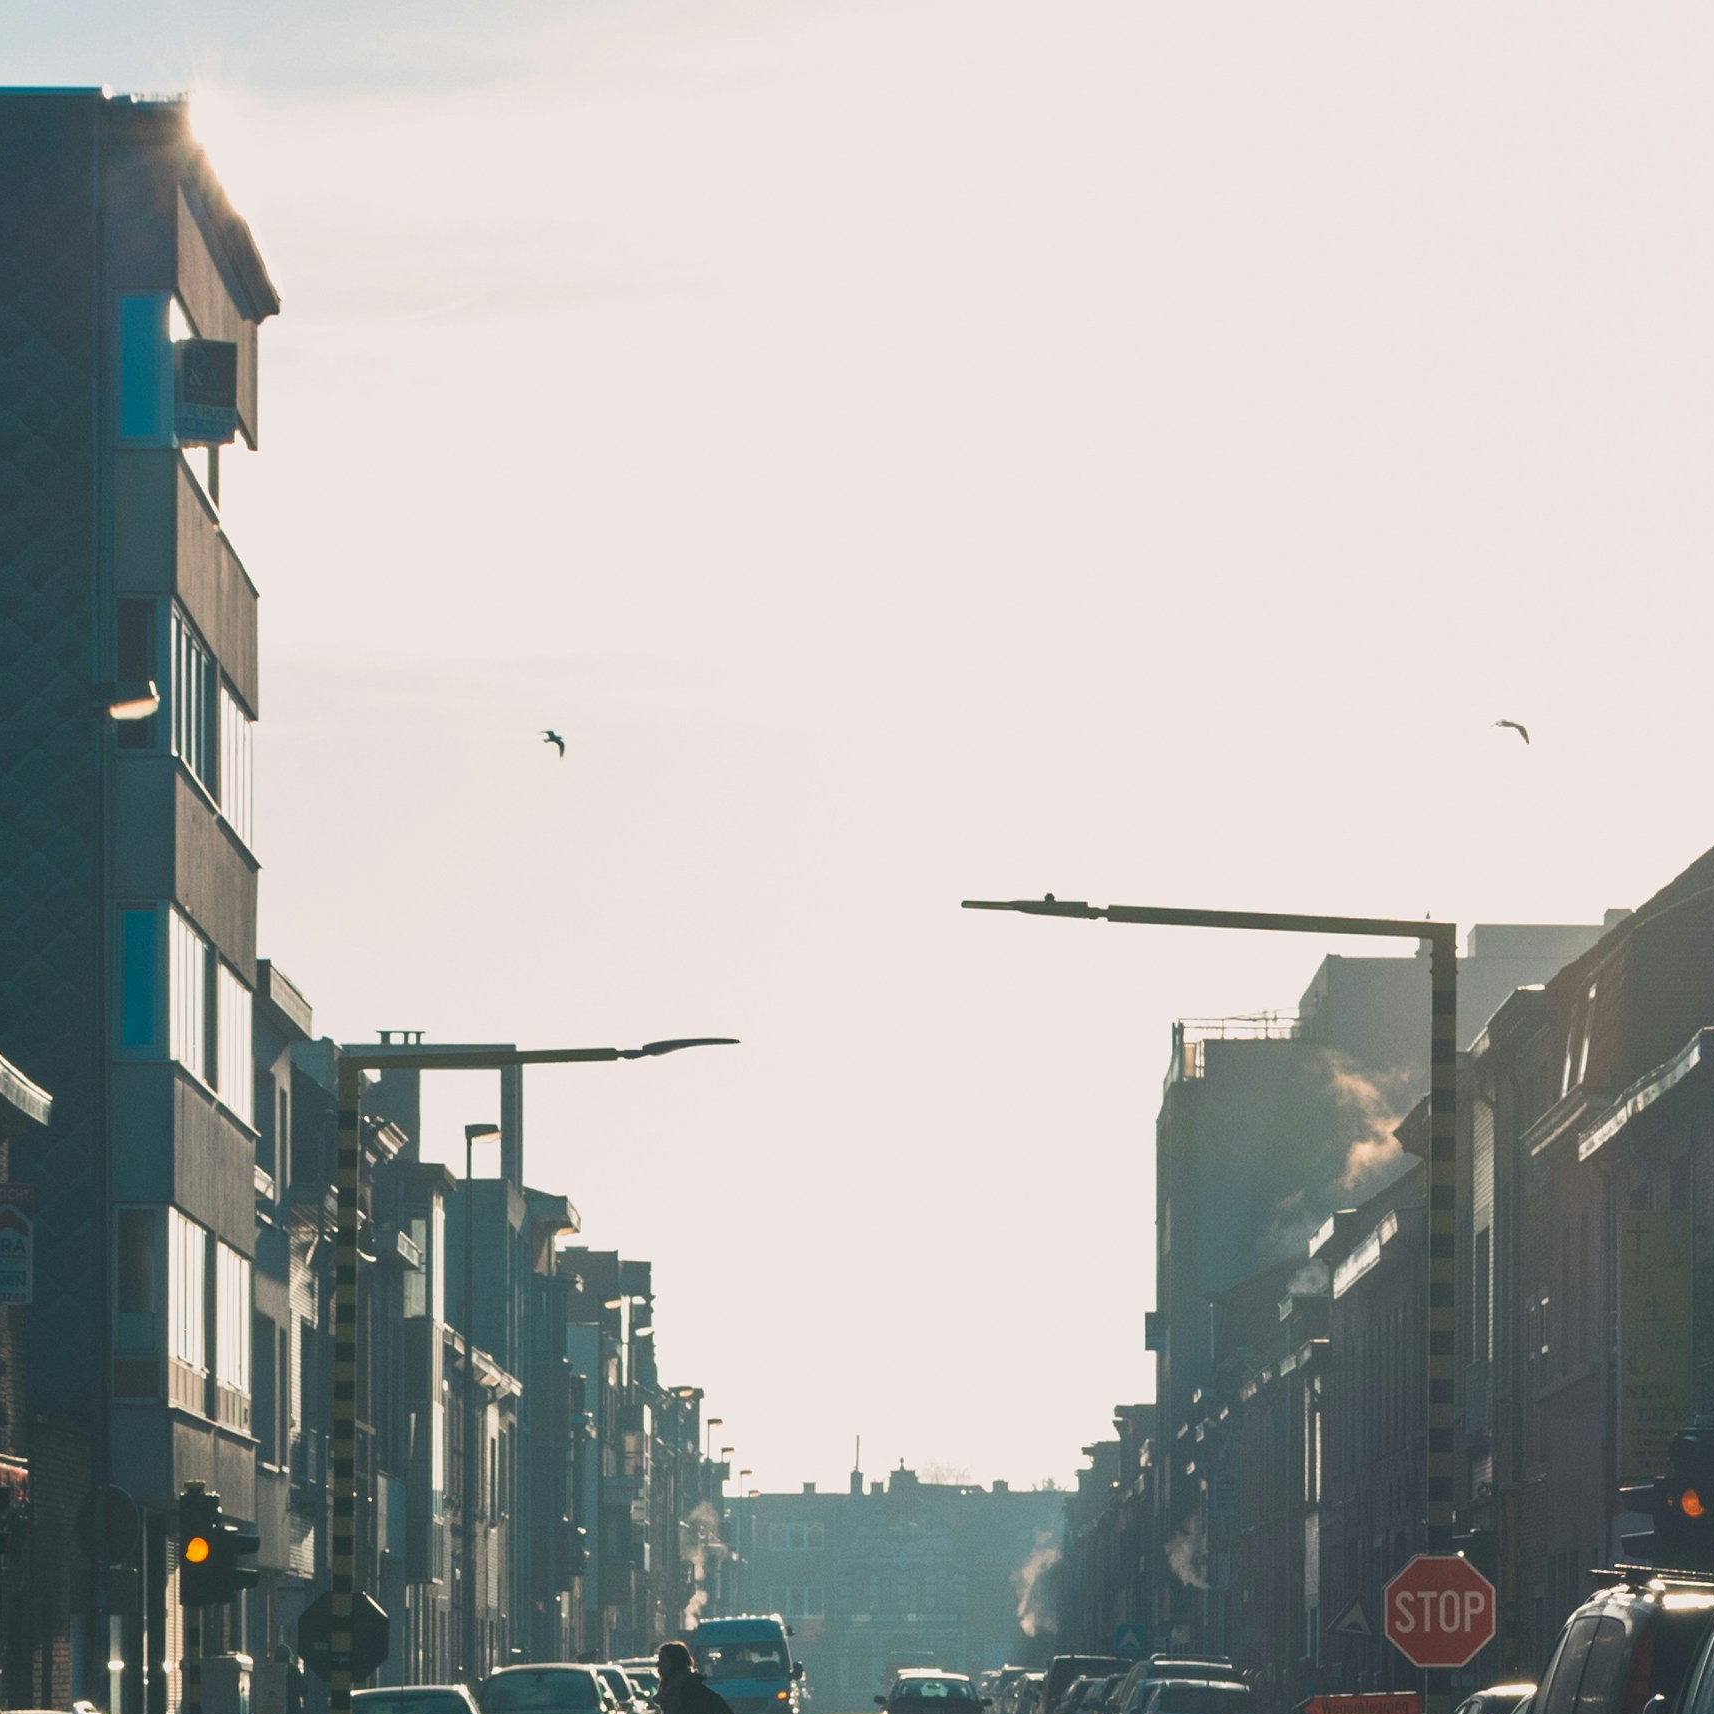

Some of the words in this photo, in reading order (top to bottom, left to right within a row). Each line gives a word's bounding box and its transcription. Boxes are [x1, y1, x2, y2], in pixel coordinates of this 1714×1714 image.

[1624, 1384, 1673, 1399] NEW
[1637, 1407, 1687, 1422] LIFE
[1394, 1589, 1486, 1634] STOP
